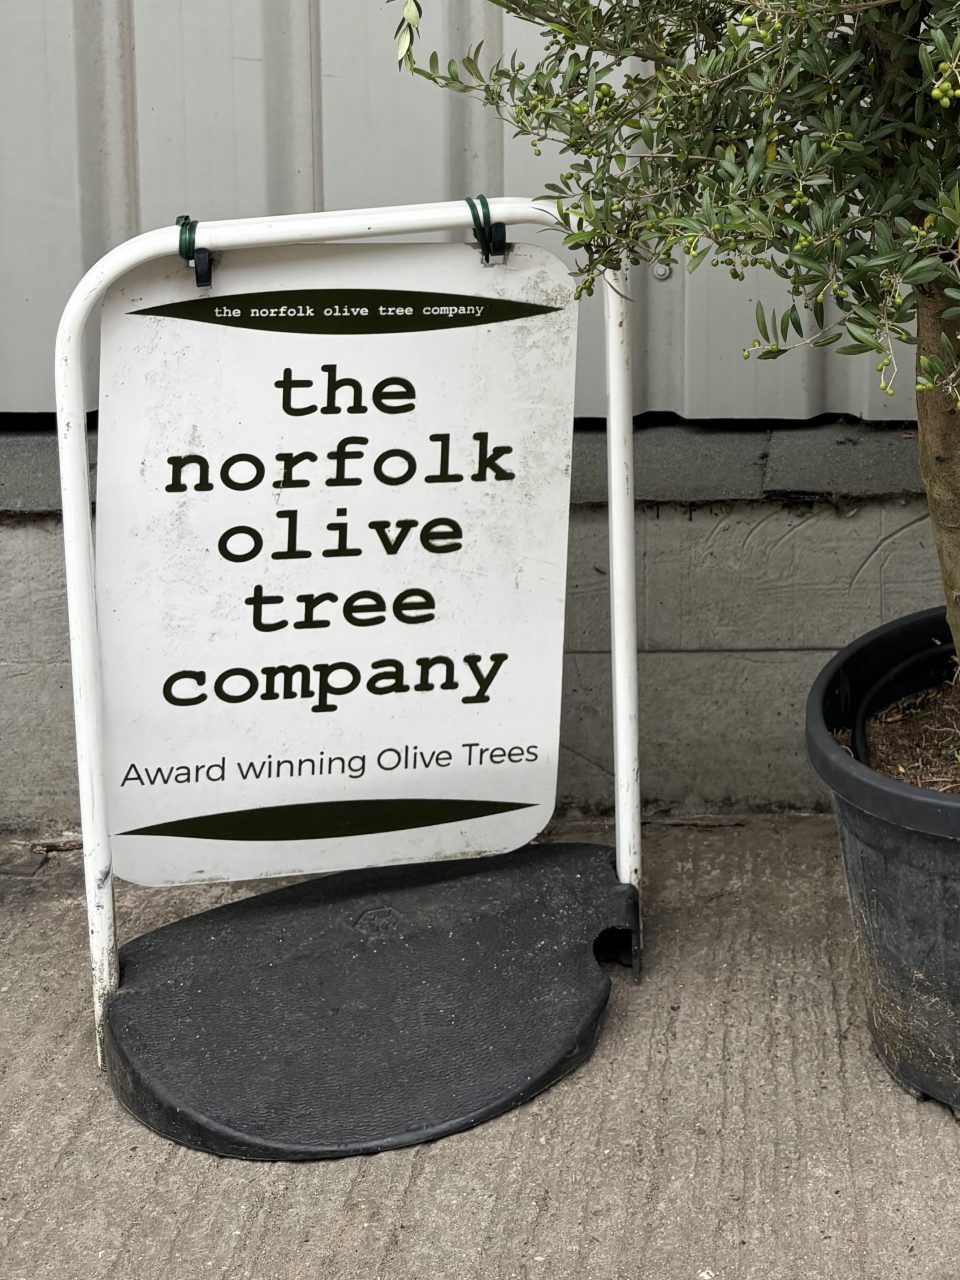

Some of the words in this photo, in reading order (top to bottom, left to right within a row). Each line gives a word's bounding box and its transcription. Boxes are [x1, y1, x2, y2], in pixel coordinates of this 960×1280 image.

[214, 306, 241, 318] the
[250, 305, 315, 317] norfolk
[323, 305, 369, 317] olive
[378, 305, 414, 316] tree
[422, 305, 484, 317] company
[274, 364, 416, 417] the
[165, 432, 516, 493] norfolk
[217, 507, 463, 563] olive
[244, 584, 436, 633] tree
[162, 653, 509, 713] company
[120, 756, 227, 787] Award
[236, 750, 367, 780] winning
[376, 745, 453, 771] Olive
[461, 742, 539, 766] Trees
